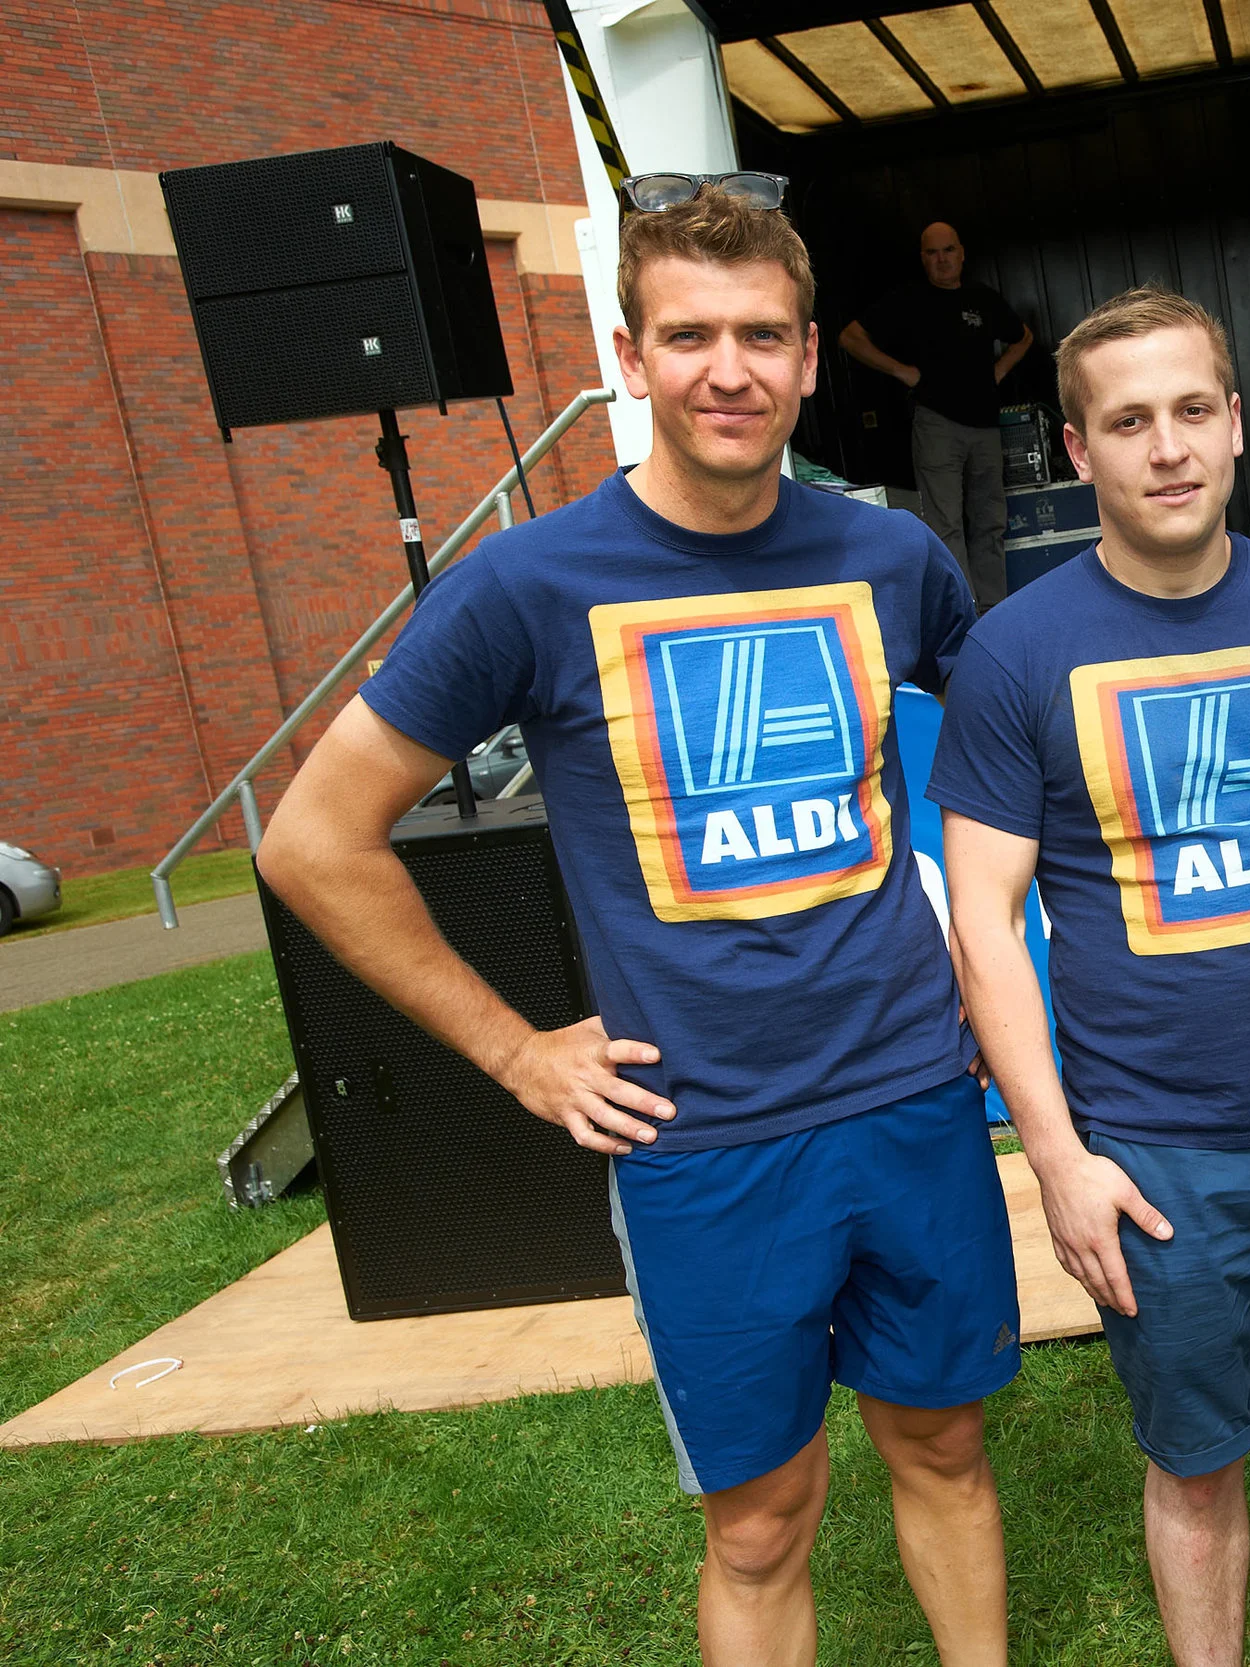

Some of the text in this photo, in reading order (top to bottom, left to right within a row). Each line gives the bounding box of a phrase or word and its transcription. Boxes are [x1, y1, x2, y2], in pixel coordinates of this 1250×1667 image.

[335, 204, 351, 218] HK
[363, 338, 379, 351] HK
[701, 793, 859, 864] ALDI
